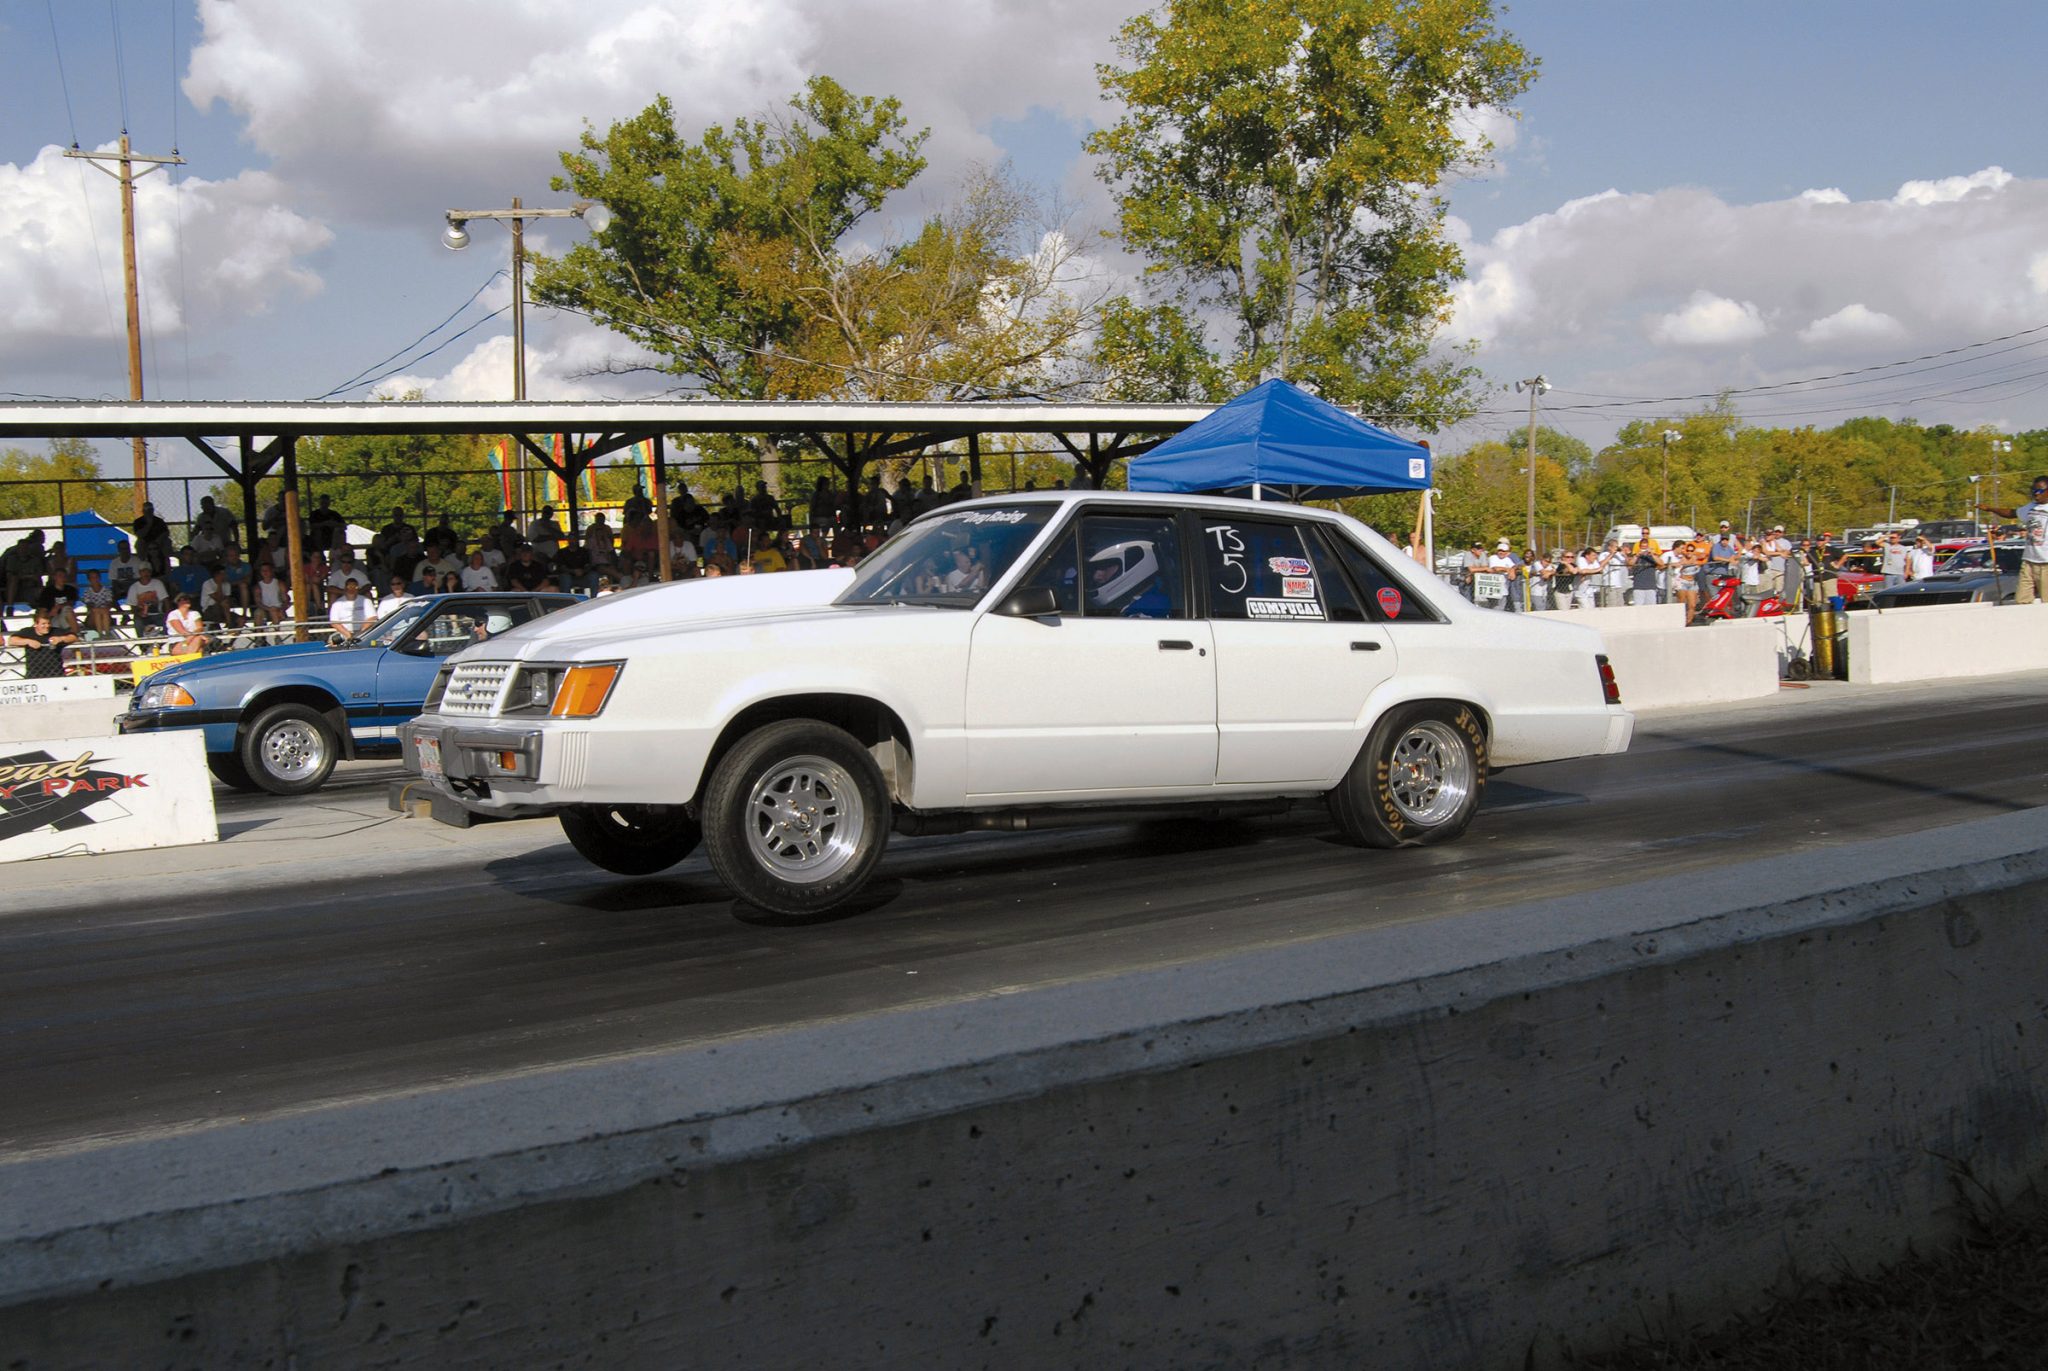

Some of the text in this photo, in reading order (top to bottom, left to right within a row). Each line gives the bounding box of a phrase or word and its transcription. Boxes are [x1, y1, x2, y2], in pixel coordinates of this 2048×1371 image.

[1205, 526, 1245, 551] TS
[1220, 553, 1247, 593] 5
[1249, 601, 1323, 615] COMPUCAR
[41, 773, 150, 797] PARK
